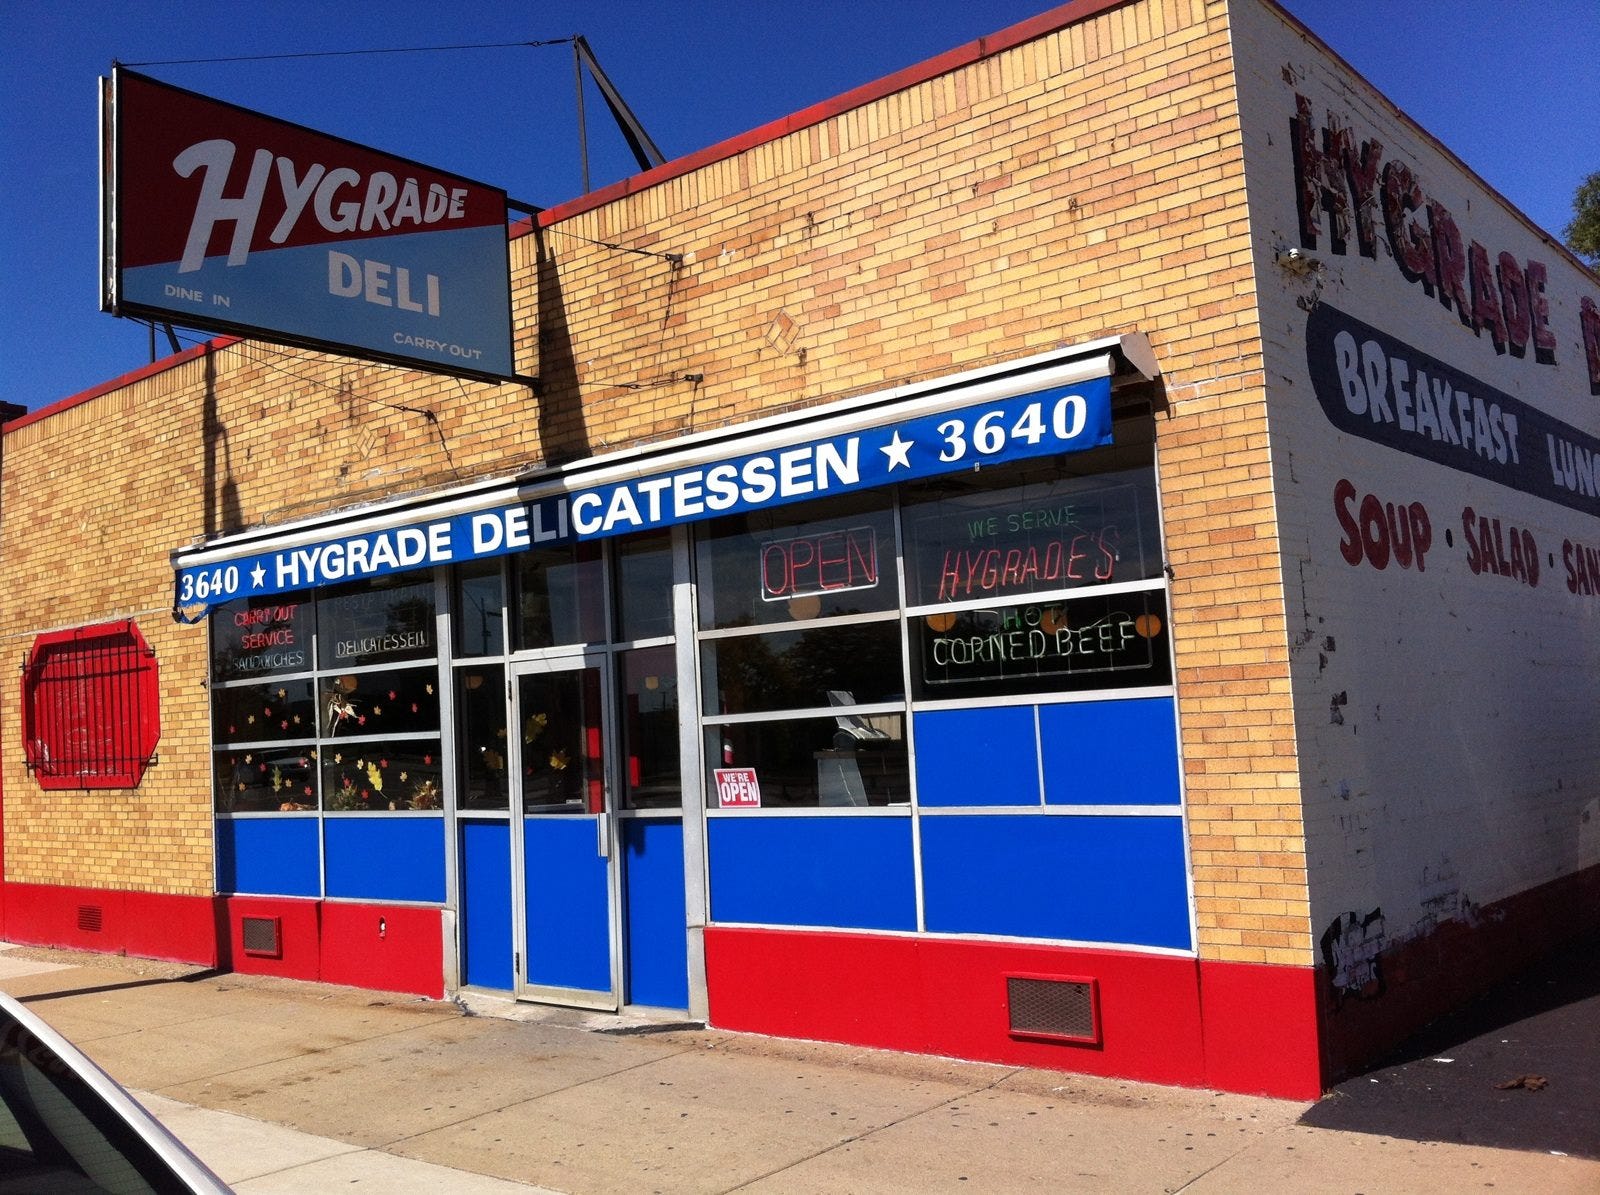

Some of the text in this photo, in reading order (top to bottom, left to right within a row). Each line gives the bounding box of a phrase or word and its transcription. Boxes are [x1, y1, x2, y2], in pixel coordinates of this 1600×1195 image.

[172, 139, 469, 274] HYGRADE
[1289, 92, 1557, 366] HYGRADE
[164, 284, 231, 308] DINE IN
[328, 250, 441, 318] DELI
[393, 331, 482, 360] CARRY OUT
[1333, 329, 1520, 466] BREAKFAST
[180, 395, 1088, 602] 3640 HYGRADE DELICATESSEN 3640
[967, 505, 1078, 541] WE SERVE
[1333, 478, 1432, 573] SOUP
[1461, 506, 1540, 588] SALAD
[762, 531, 877, 595] OPEN
[938, 526, 1120, 600] HYGRADE'S
[234, 604, 298, 627] CARRY OUT
[1003, 602, 1064, 630] HOT
[241, 629, 294, 649] SERVICE
[337, 630, 426, 657] DELICATESSEN
[933, 620, 1136, 666] CORNED BEEF
[720, 781, 758, 803] OPEN
[722, 772, 750, 784] WE'RE
